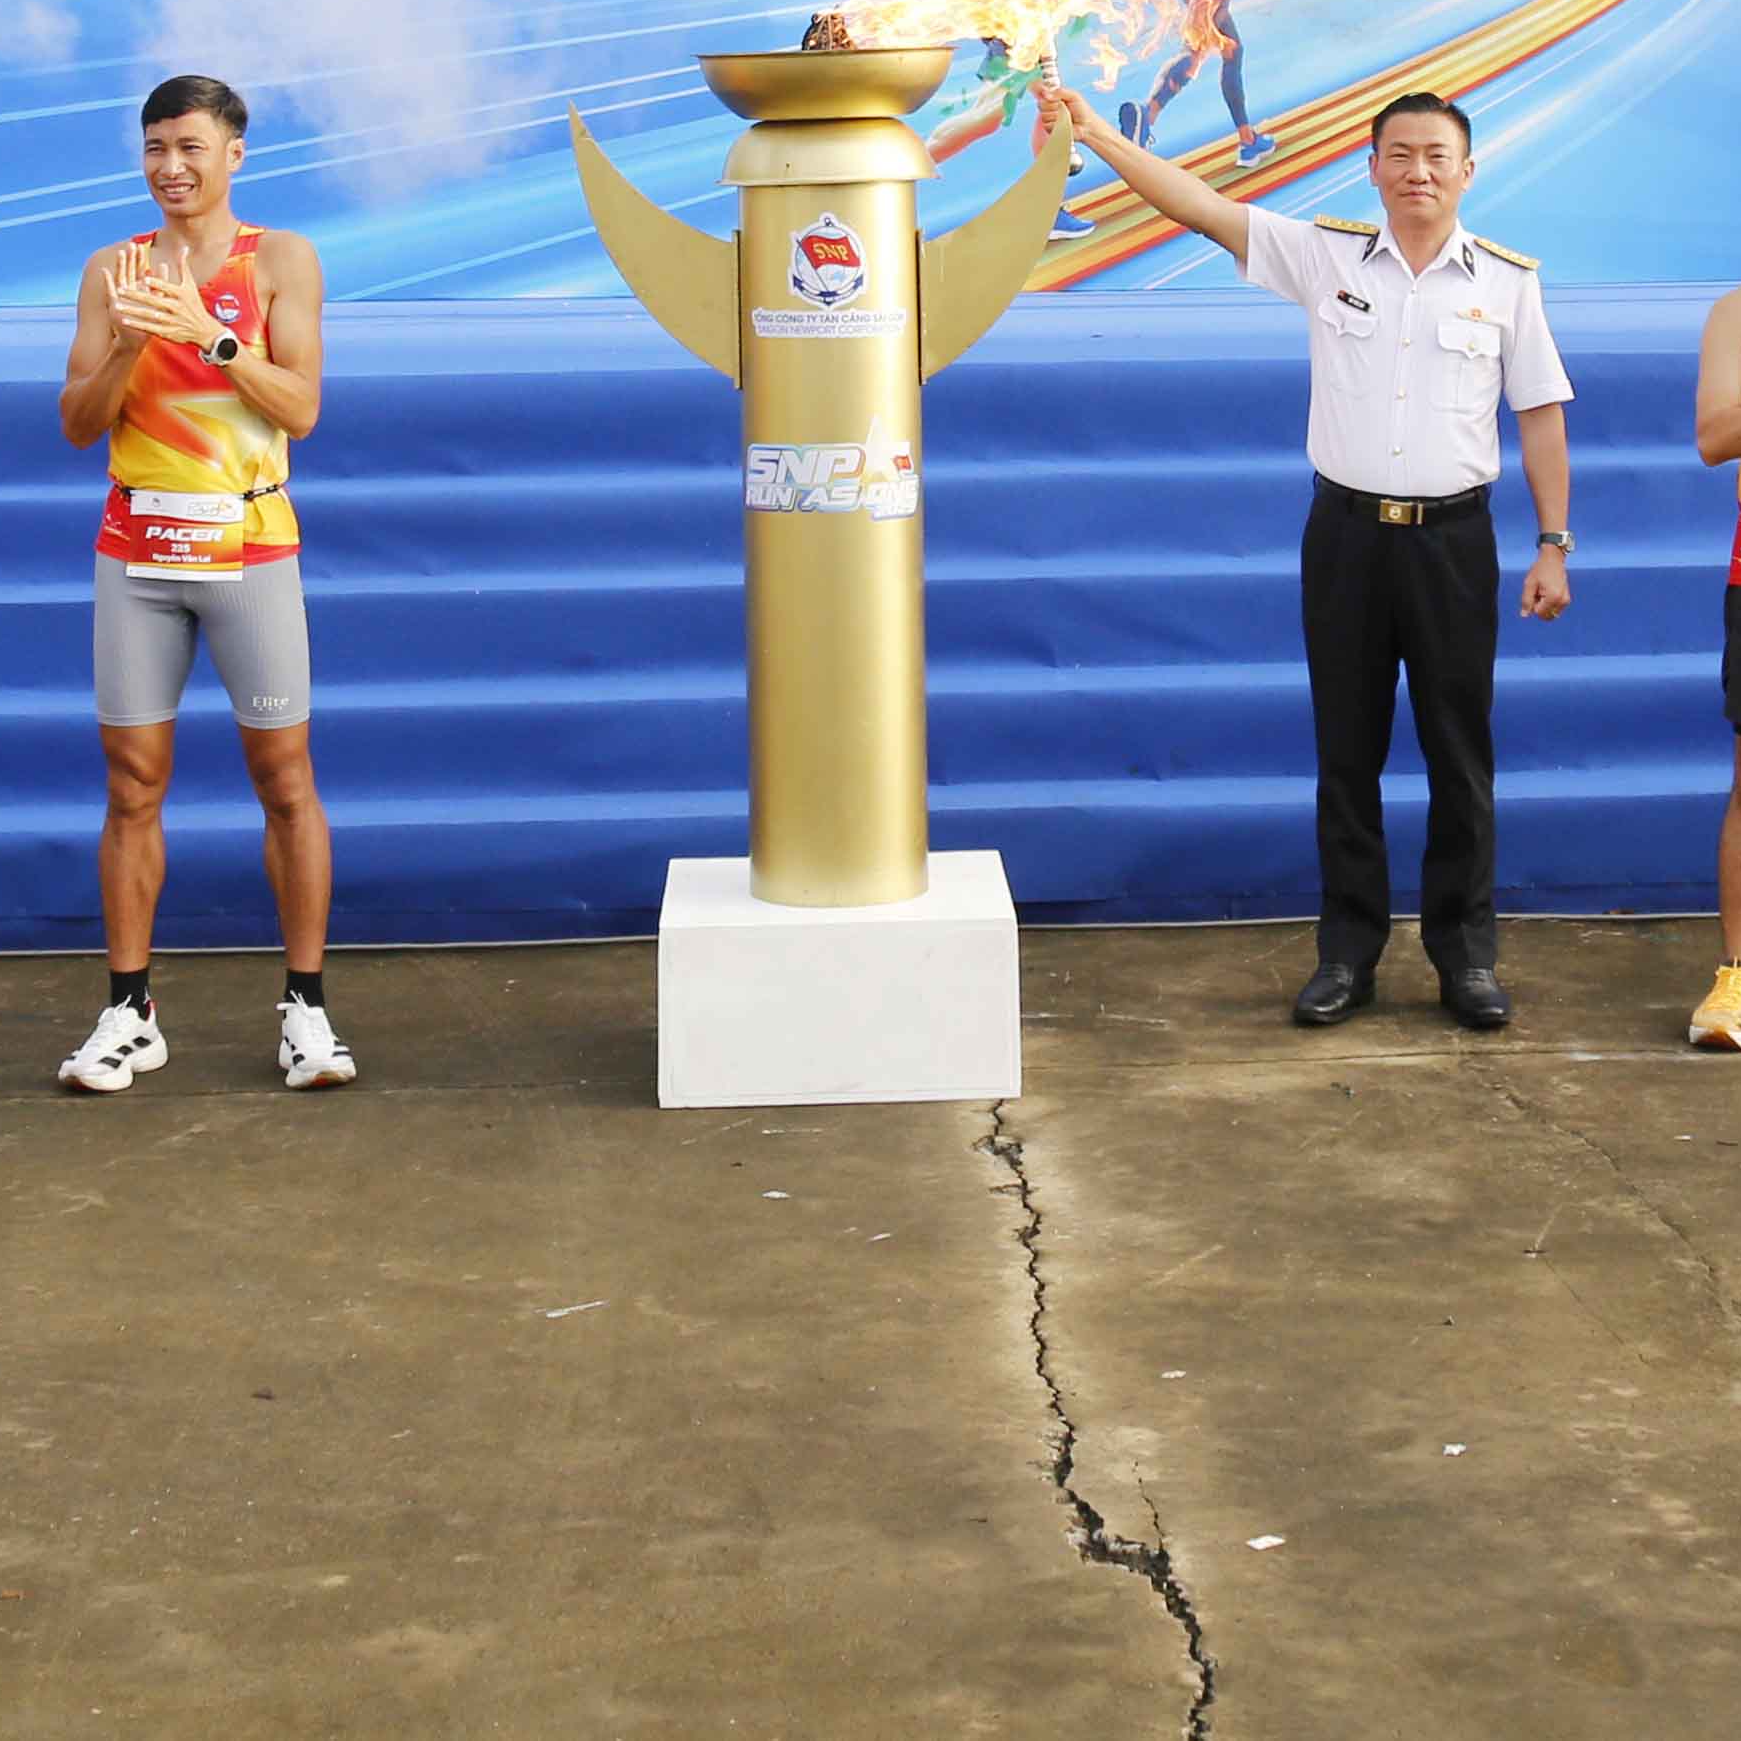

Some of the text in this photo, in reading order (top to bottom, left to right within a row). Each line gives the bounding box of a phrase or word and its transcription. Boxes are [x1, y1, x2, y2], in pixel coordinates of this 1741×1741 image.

[812, 241, 851, 262] SNP
[747, 445, 865, 485] SNP
[746, 483, 796, 512] RUN
[145, 525, 225, 542] PACER
